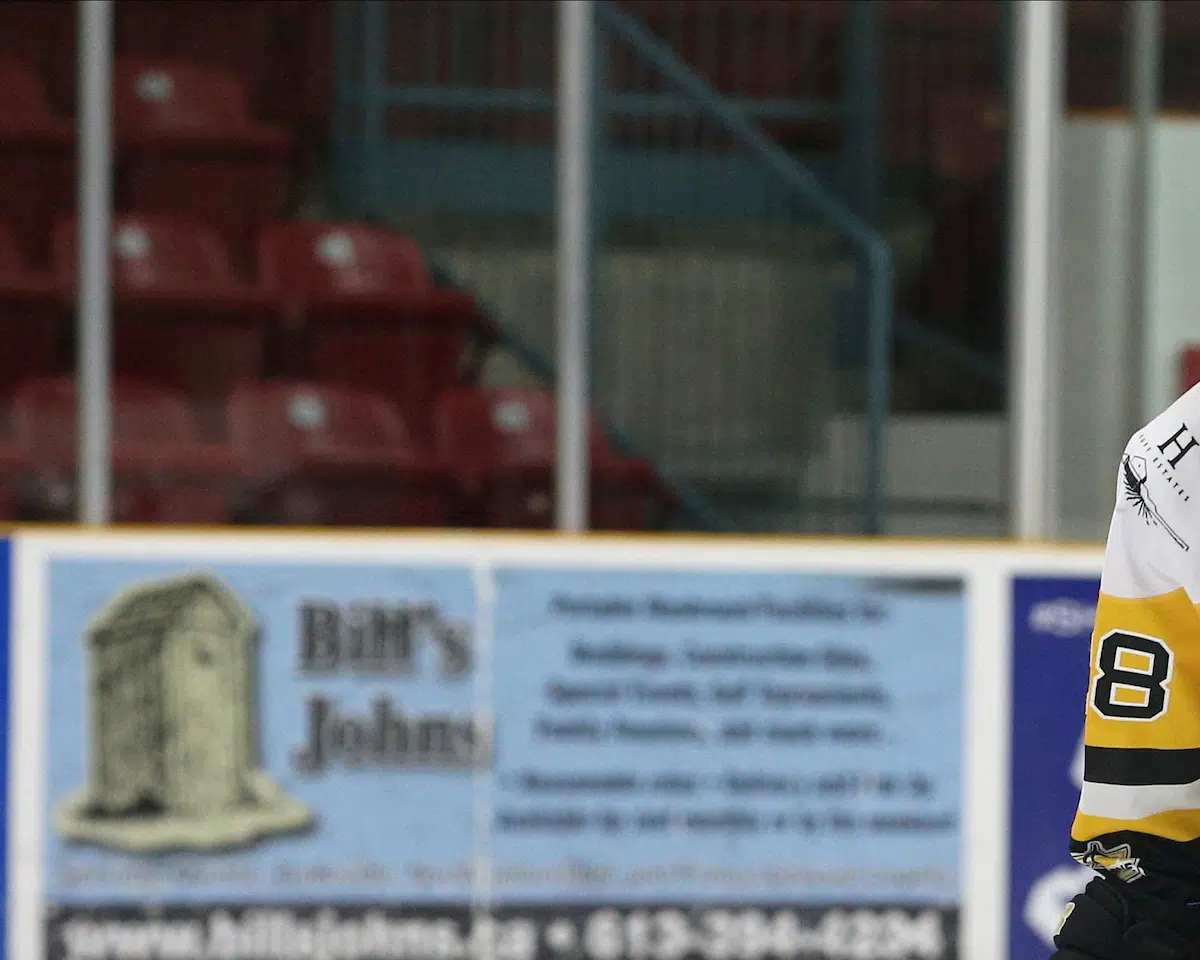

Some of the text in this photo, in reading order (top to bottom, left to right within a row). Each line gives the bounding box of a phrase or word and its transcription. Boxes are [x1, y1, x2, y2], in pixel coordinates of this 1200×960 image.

[1157, 423, 1200, 469] H
[299, 598, 475, 682] Bill's
[1088, 628, 1174, 722] 8
[291, 692, 494, 779] Johns
